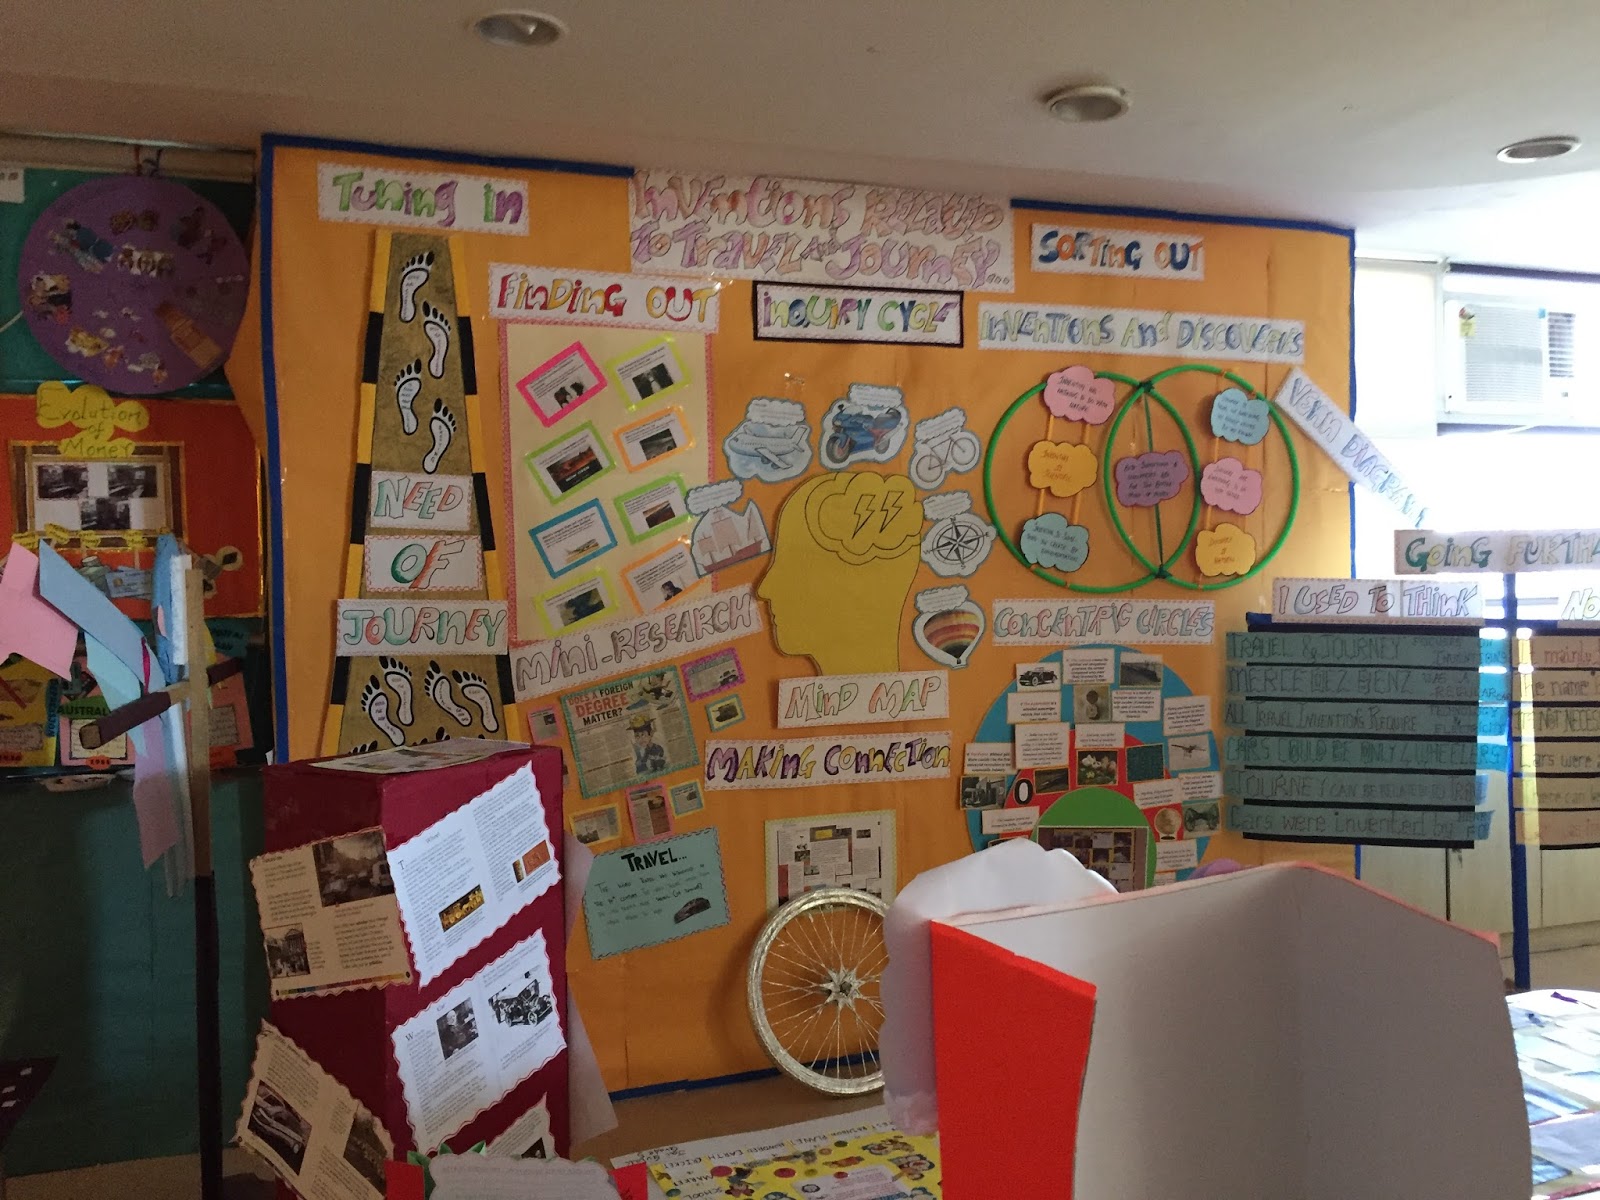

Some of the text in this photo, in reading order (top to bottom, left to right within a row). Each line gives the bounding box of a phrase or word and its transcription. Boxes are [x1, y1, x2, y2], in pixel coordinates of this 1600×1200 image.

[646, 285, 721, 323] OUT
[374, 476, 464, 519] NEED
[391, 540, 465, 588] OF
[1294, 584, 1359, 615] USED
[575, 692, 629, 718] DEGREE
[600, 682, 634, 697] FOREIGN
[869, 675, 941, 715] MAP
[582, 707, 624, 726] MATTER?
